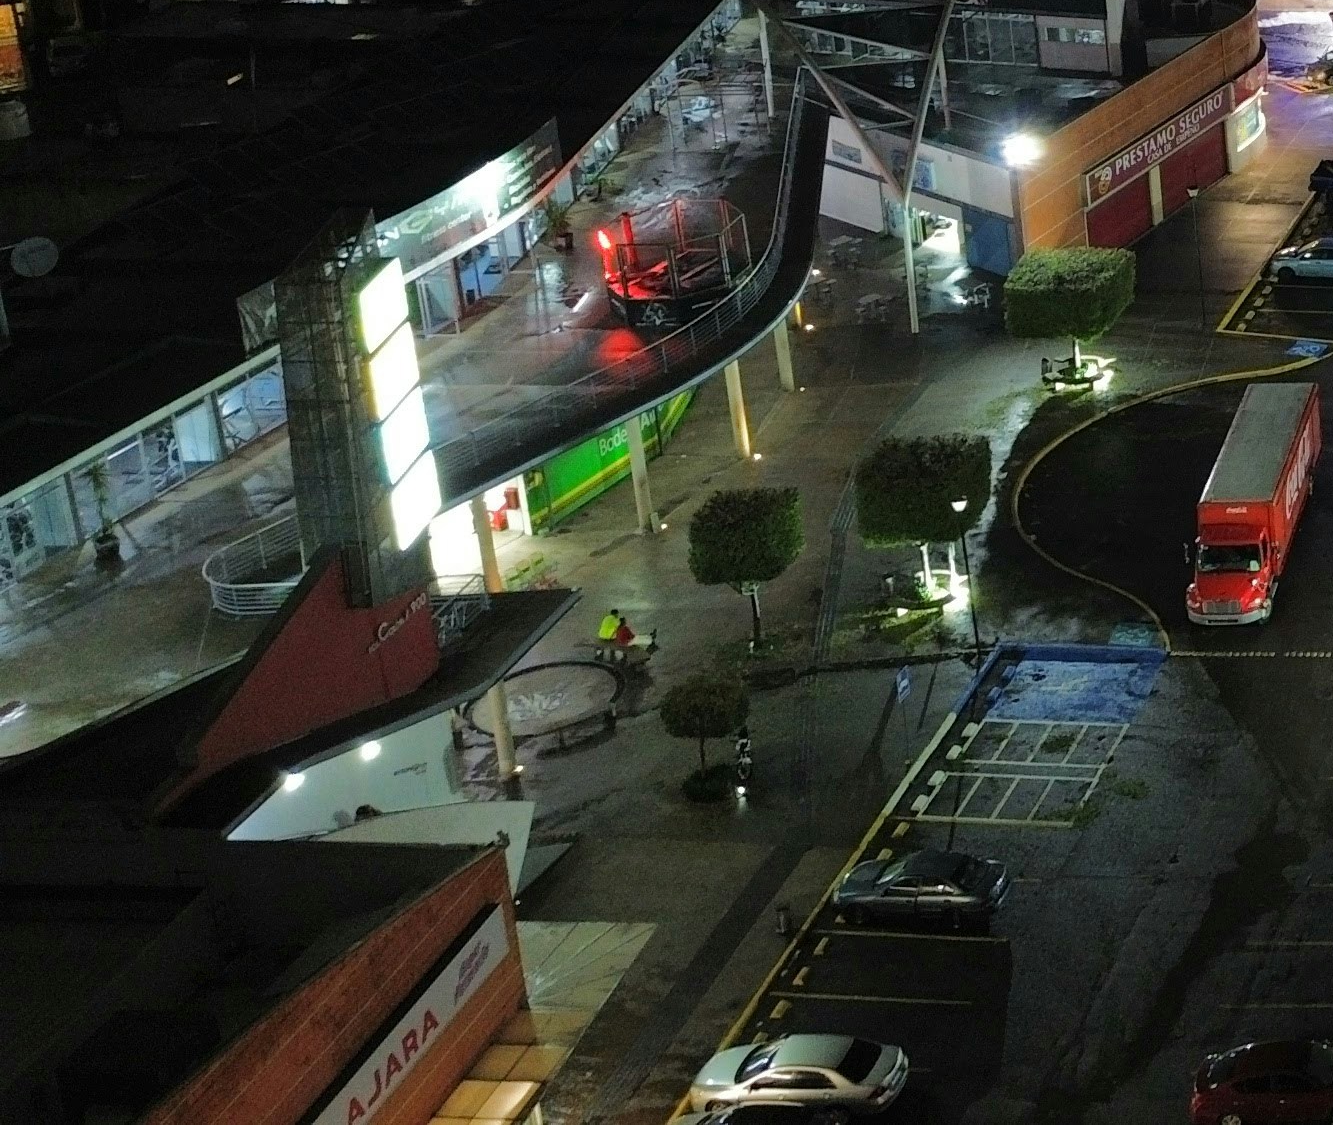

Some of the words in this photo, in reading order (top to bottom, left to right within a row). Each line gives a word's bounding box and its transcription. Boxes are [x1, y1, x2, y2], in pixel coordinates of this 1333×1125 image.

[1115, 125, 1176, 175] PRESTAMO
[1179, 92, 1223, 133] SEGURO
[1164, 141, 1173, 155] DE
